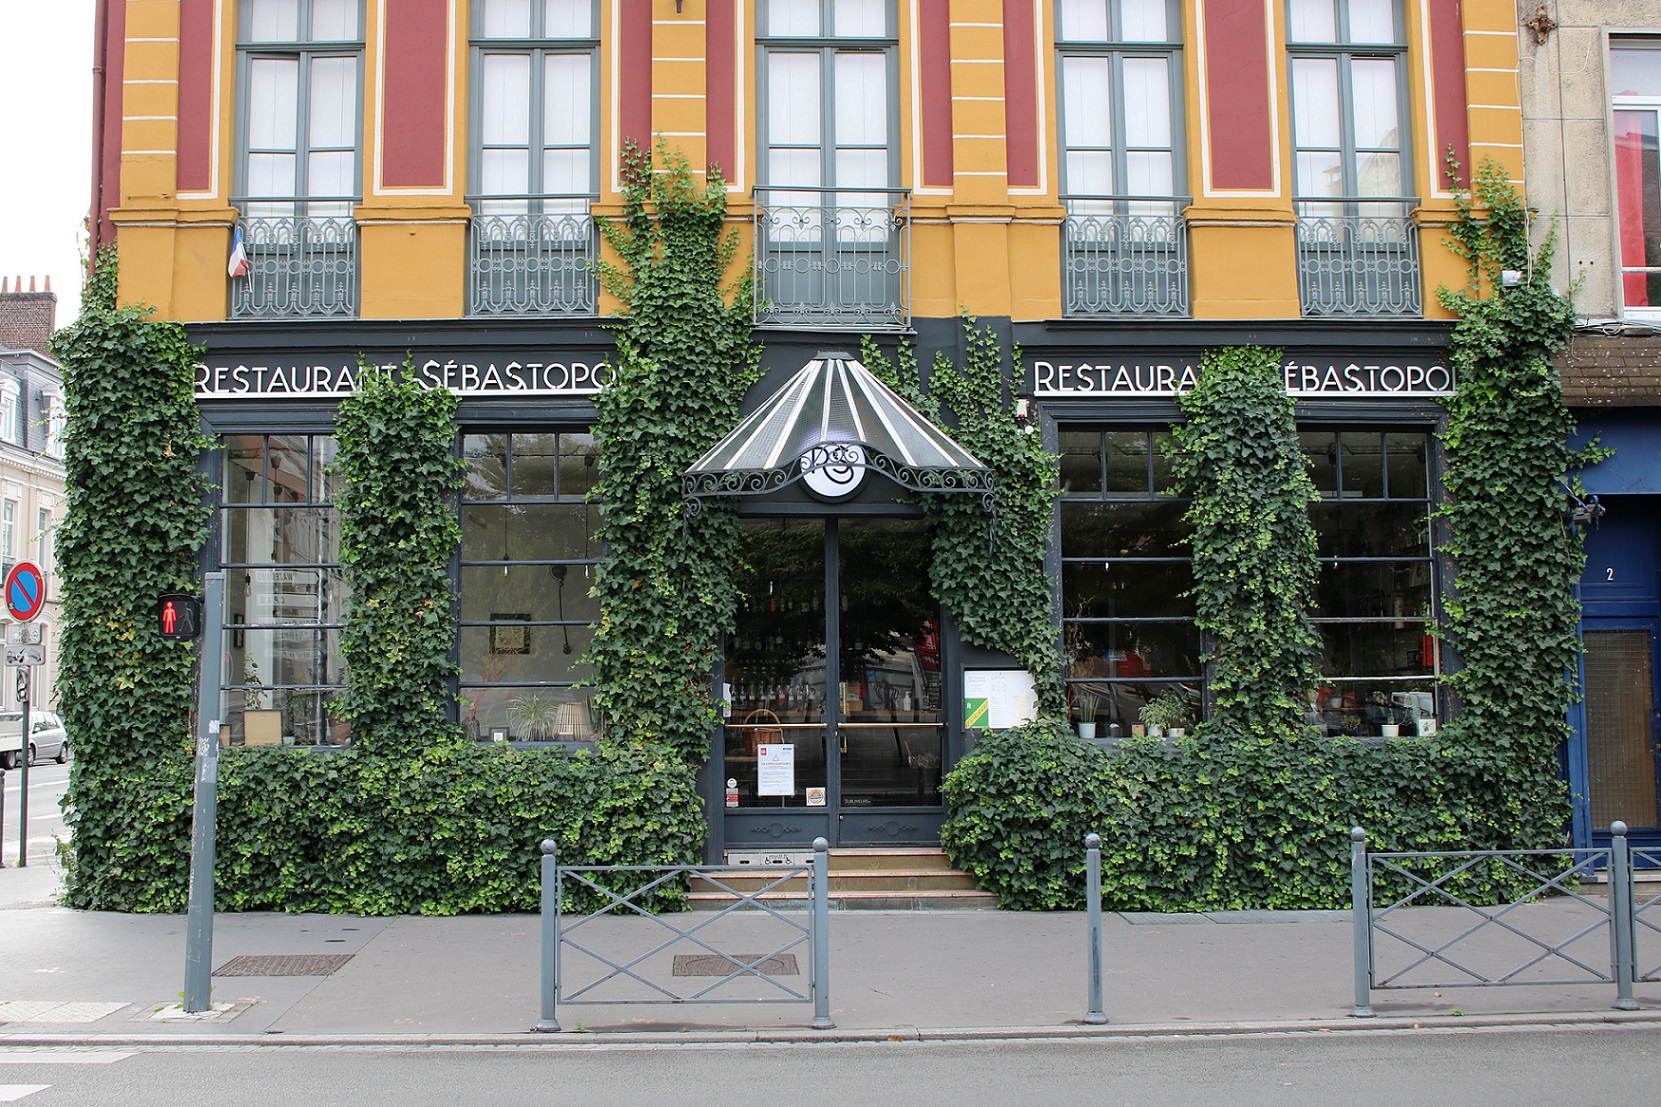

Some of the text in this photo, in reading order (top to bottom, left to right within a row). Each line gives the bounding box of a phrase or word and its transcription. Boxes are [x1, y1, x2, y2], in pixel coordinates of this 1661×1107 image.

[409, 360, 624, 391] SÉBASTOPO
[1034, 361, 1200, 392] RESTAURA
[1606, 567, 1614, 581] 2
